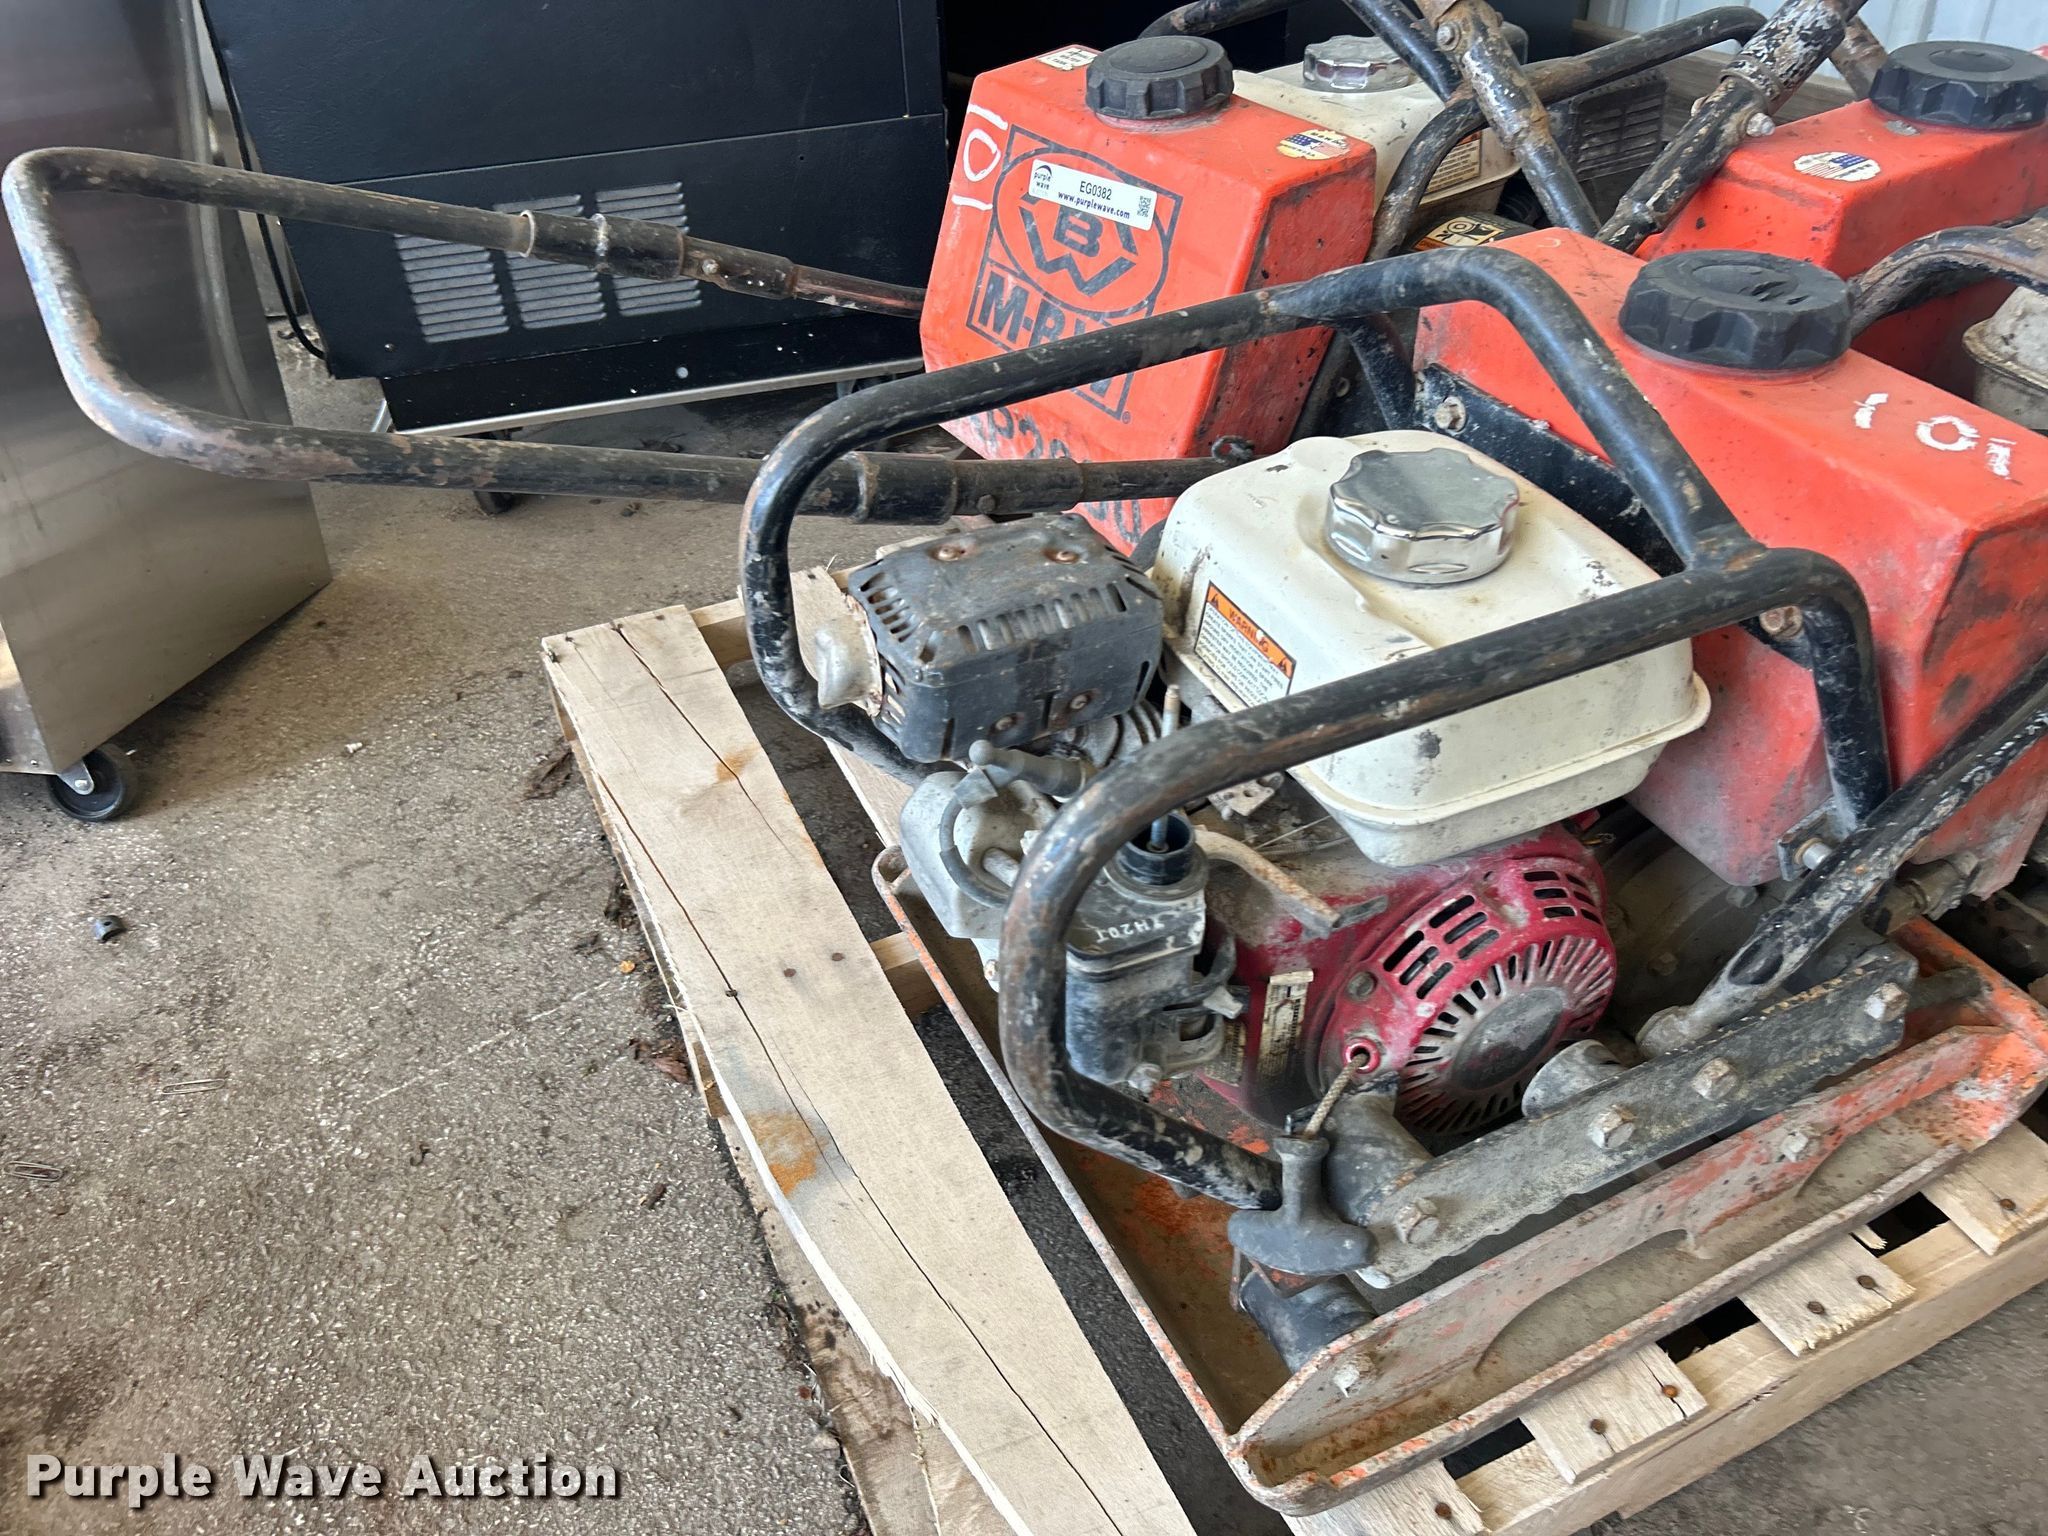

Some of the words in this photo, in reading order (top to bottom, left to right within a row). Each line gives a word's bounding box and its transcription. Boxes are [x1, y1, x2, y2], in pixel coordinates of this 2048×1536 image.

[1033, 171, 1052, 182] purple
[1035, 181, 1050, 191] wave
[1079, 180, 1112, 201] EG0382
[1058, 191, 1131, 220] www.purplewave.com
